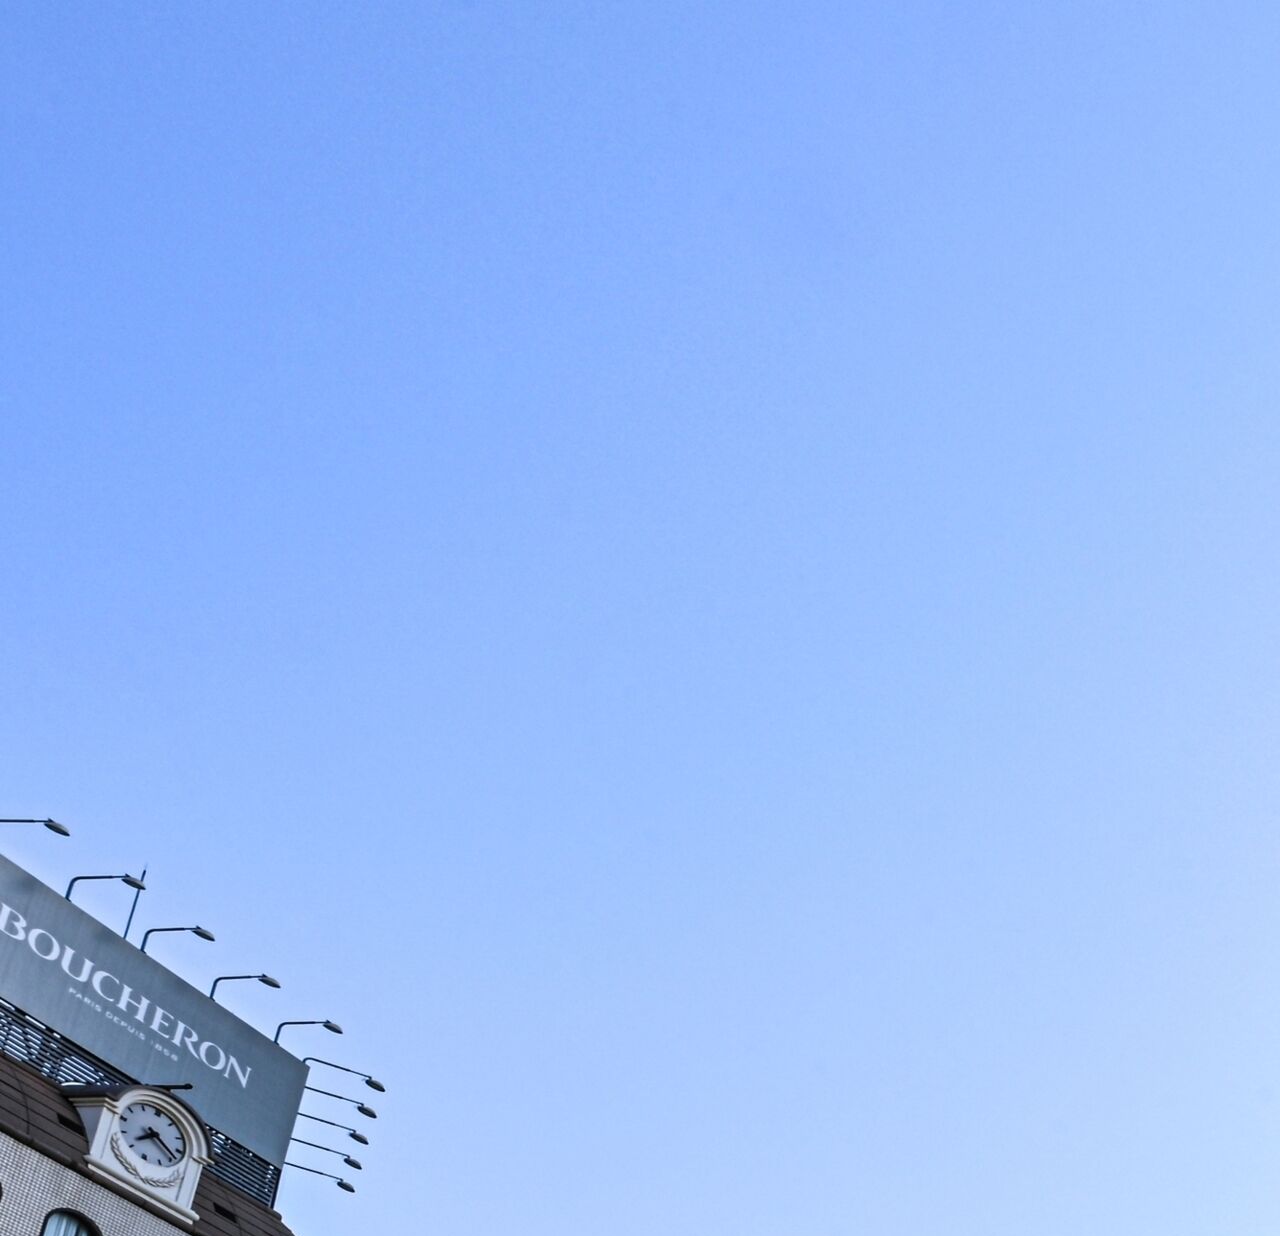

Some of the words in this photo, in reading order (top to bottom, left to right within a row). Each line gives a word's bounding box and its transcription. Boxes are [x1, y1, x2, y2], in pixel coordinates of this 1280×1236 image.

[0, 902, 252, 1089] BOUCHERON
[68, 987, 102, 1013] PARIS
[105, 1011, 147, 1041] DEPUIS
